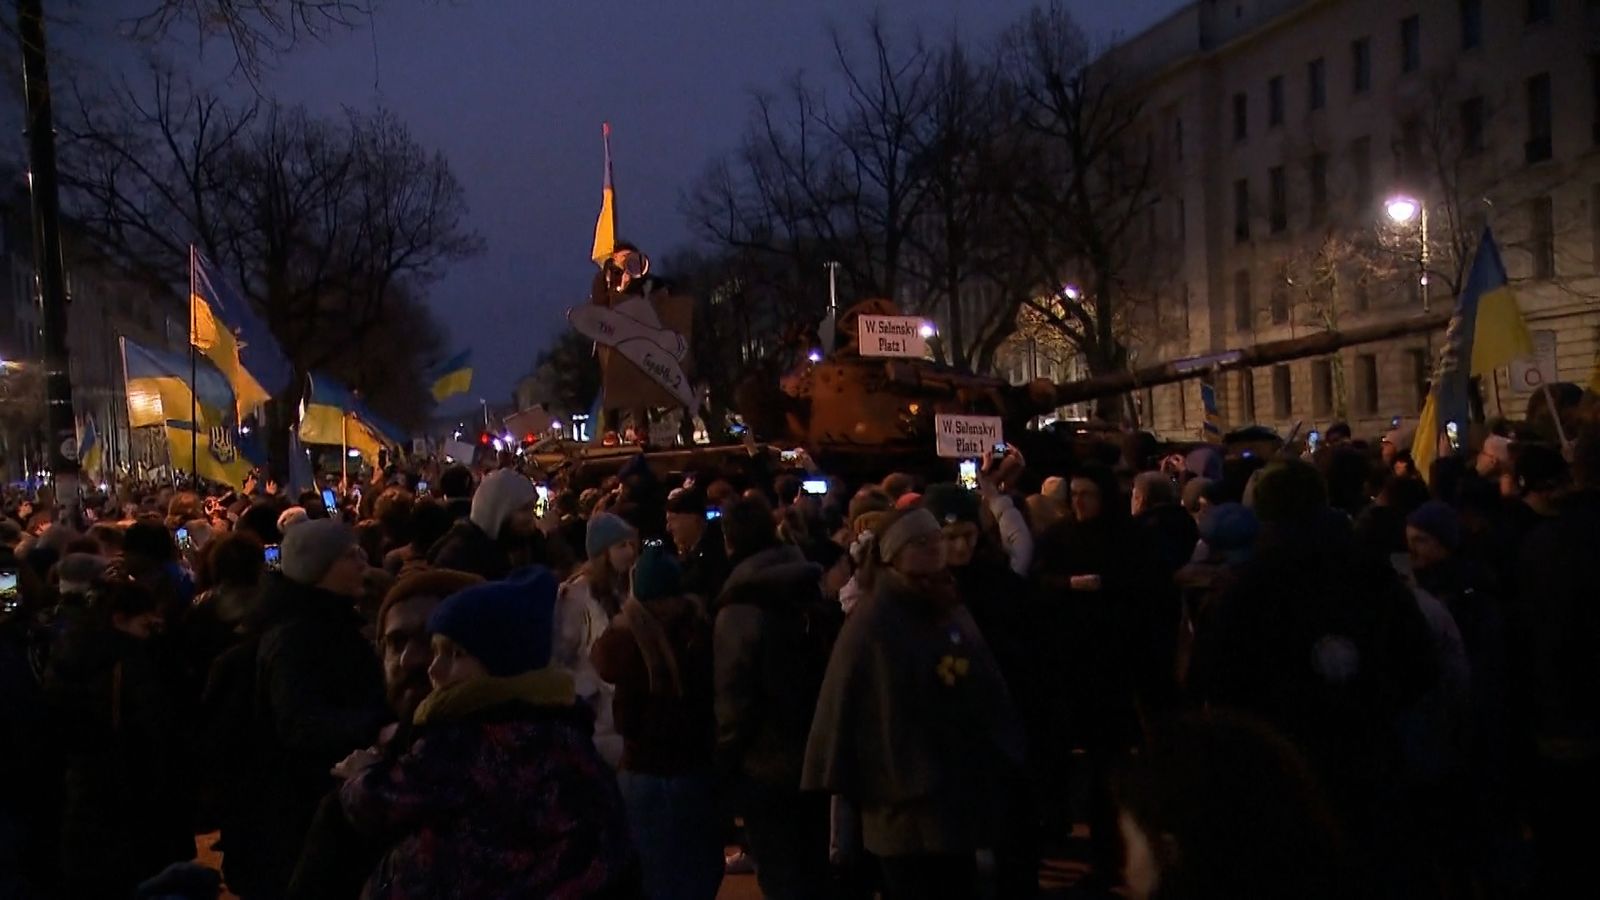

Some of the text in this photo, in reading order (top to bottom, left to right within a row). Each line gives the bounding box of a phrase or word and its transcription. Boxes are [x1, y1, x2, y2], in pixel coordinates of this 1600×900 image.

[879, 320, 919, 338] Selenskyj
[879, 337, 900, 352] Platz
[956, 420, 996, 438] Selenskyj
[956, 438, 978, 453] Platz
